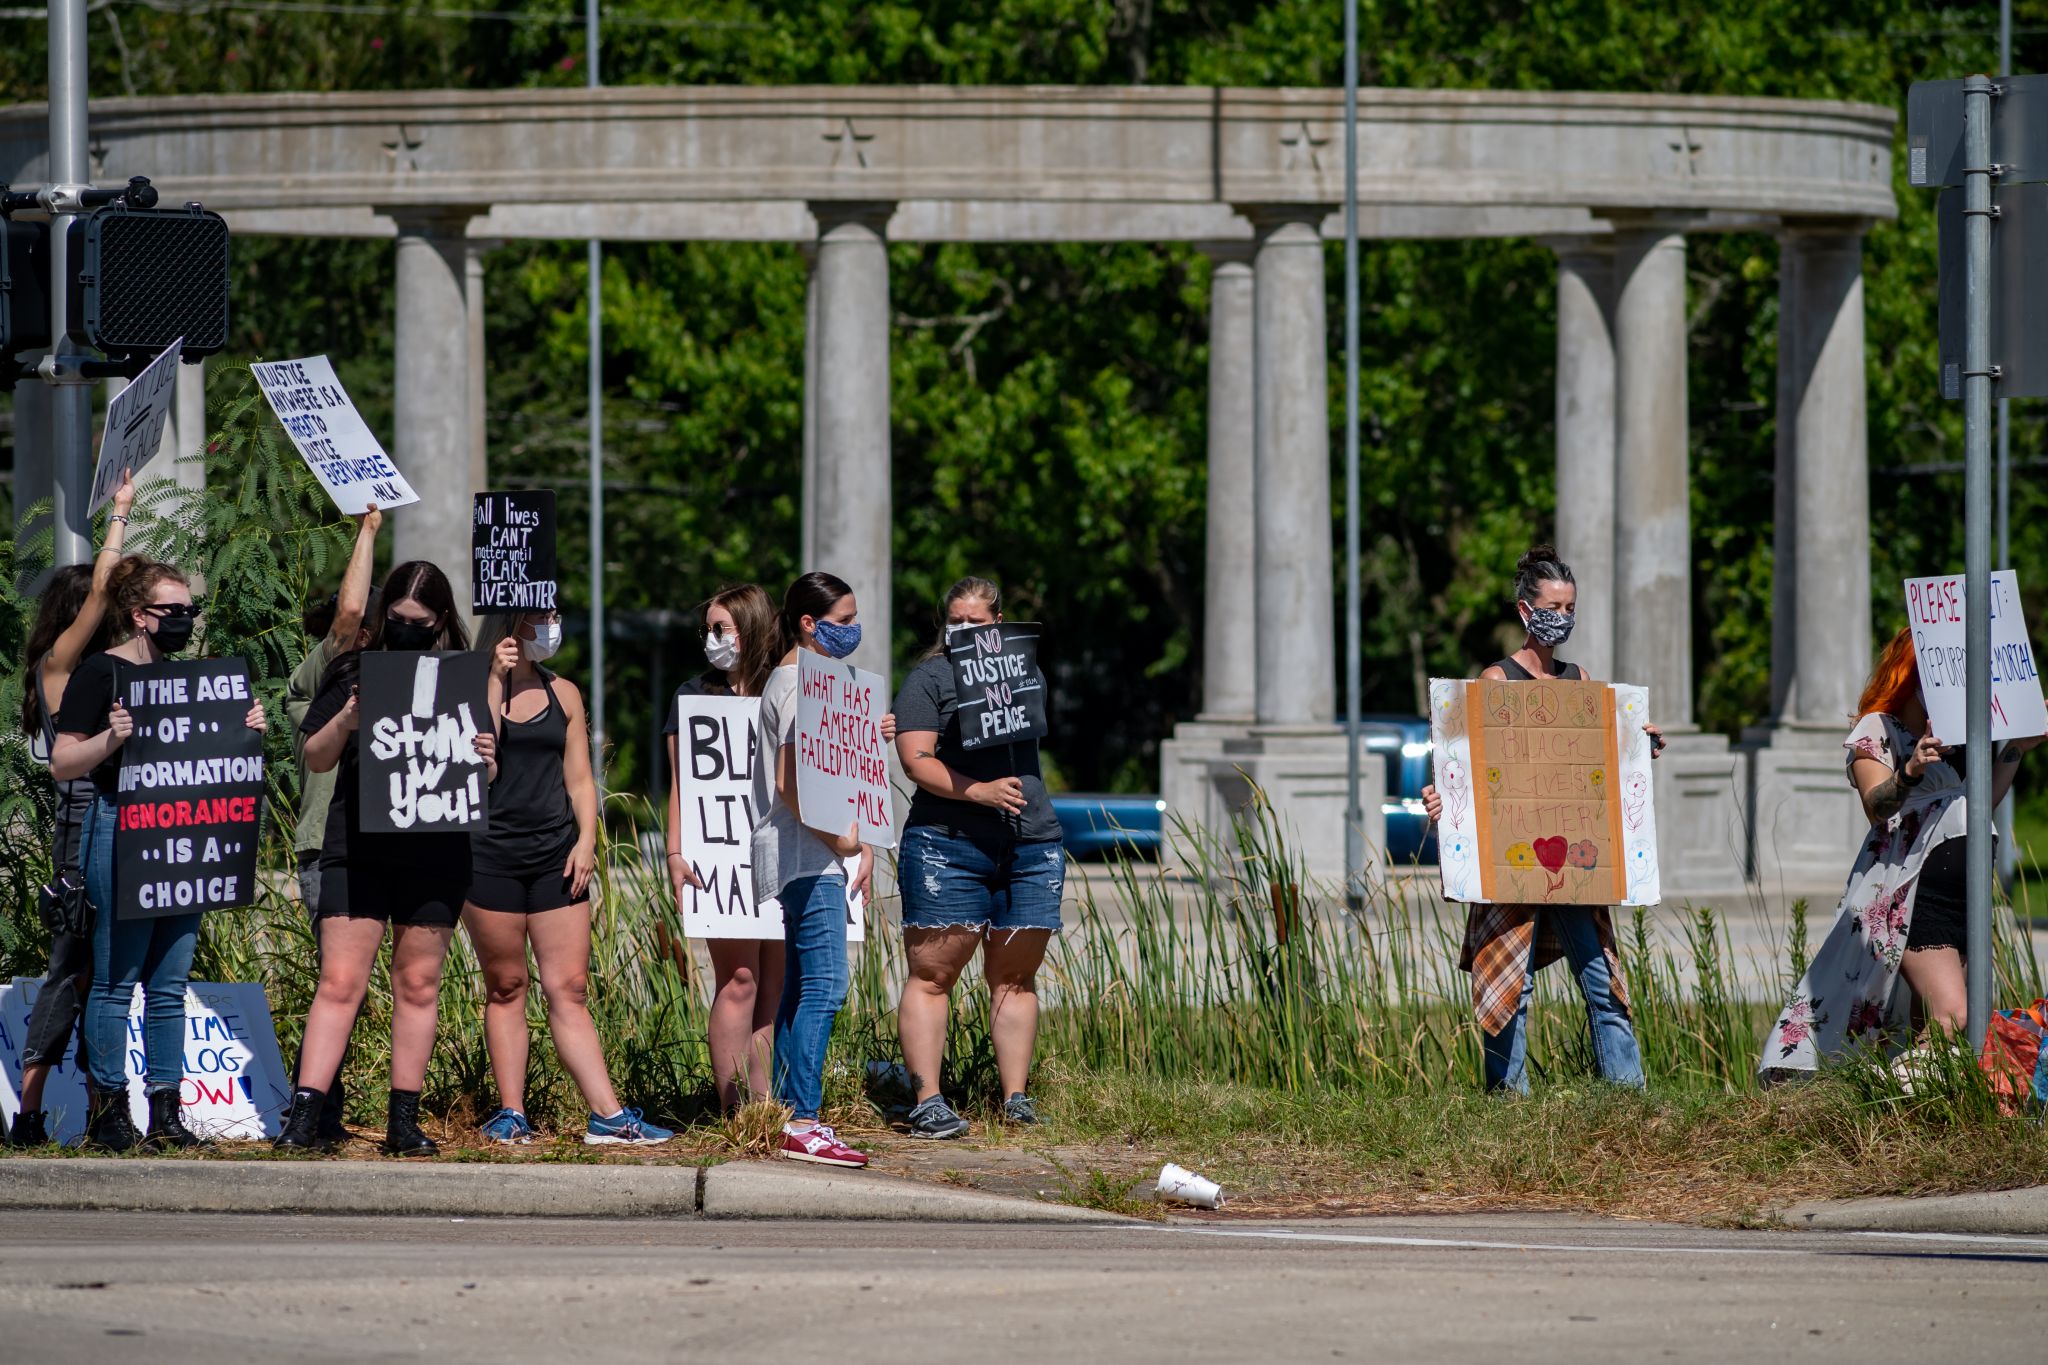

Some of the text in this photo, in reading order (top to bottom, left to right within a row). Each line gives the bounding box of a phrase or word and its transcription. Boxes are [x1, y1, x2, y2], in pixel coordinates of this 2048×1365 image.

[254, 363, 311, 388] INJUSTICE
[269, 385, 345, 413] ANYWHERE IS A
[105, 395, 125, 442] NO
[282, 414, 327, 439] THREAT TO
[116, 407, 166, 484] PEACE
[301, 438, 341, 463] JUSTICE
[505, 496, 539, 526] lives
[475, 545, 532, 561] matter until
[480, 560, 529, 582] BLACK
[1910, 581, 1960, 624] PLEASE
[975, 628, 1002, 658] NO
[1917, 630, 2038, 688] REPURP MORIAL
[960, 653, 1027, 686] JUSTICE
[130, 674, 248, 707] IN THE AGE
[412, 655, 440, 718] I
[802, 666, 870, 716] WHAT HAS
[985, 682, 1012, 711] NO
[820, 705, 880, 757] AMERICA
[980, 705, 1031, 739] PEACE
[688, 715, 757, 781] BLA
[801, 732, 888, 789] FAILED TO HEAR
[1501, 728, 1597, 760] BLACK
[118, 756, 263, 792] INFORMATION
[1506, 768, 1587, 799] LIVES
[120, 796, 256, 831] IGNORANCE
[1499, 803, 1609, 840] MATTER
[166, 836, 221, 864] IS A
[138, 876, 238, 909] CHOICE
[184, 1015, 248, 1041] IME
[129, 1047, 243, 1075] DLOG
[179, 1076, 254, 1106] OW!
